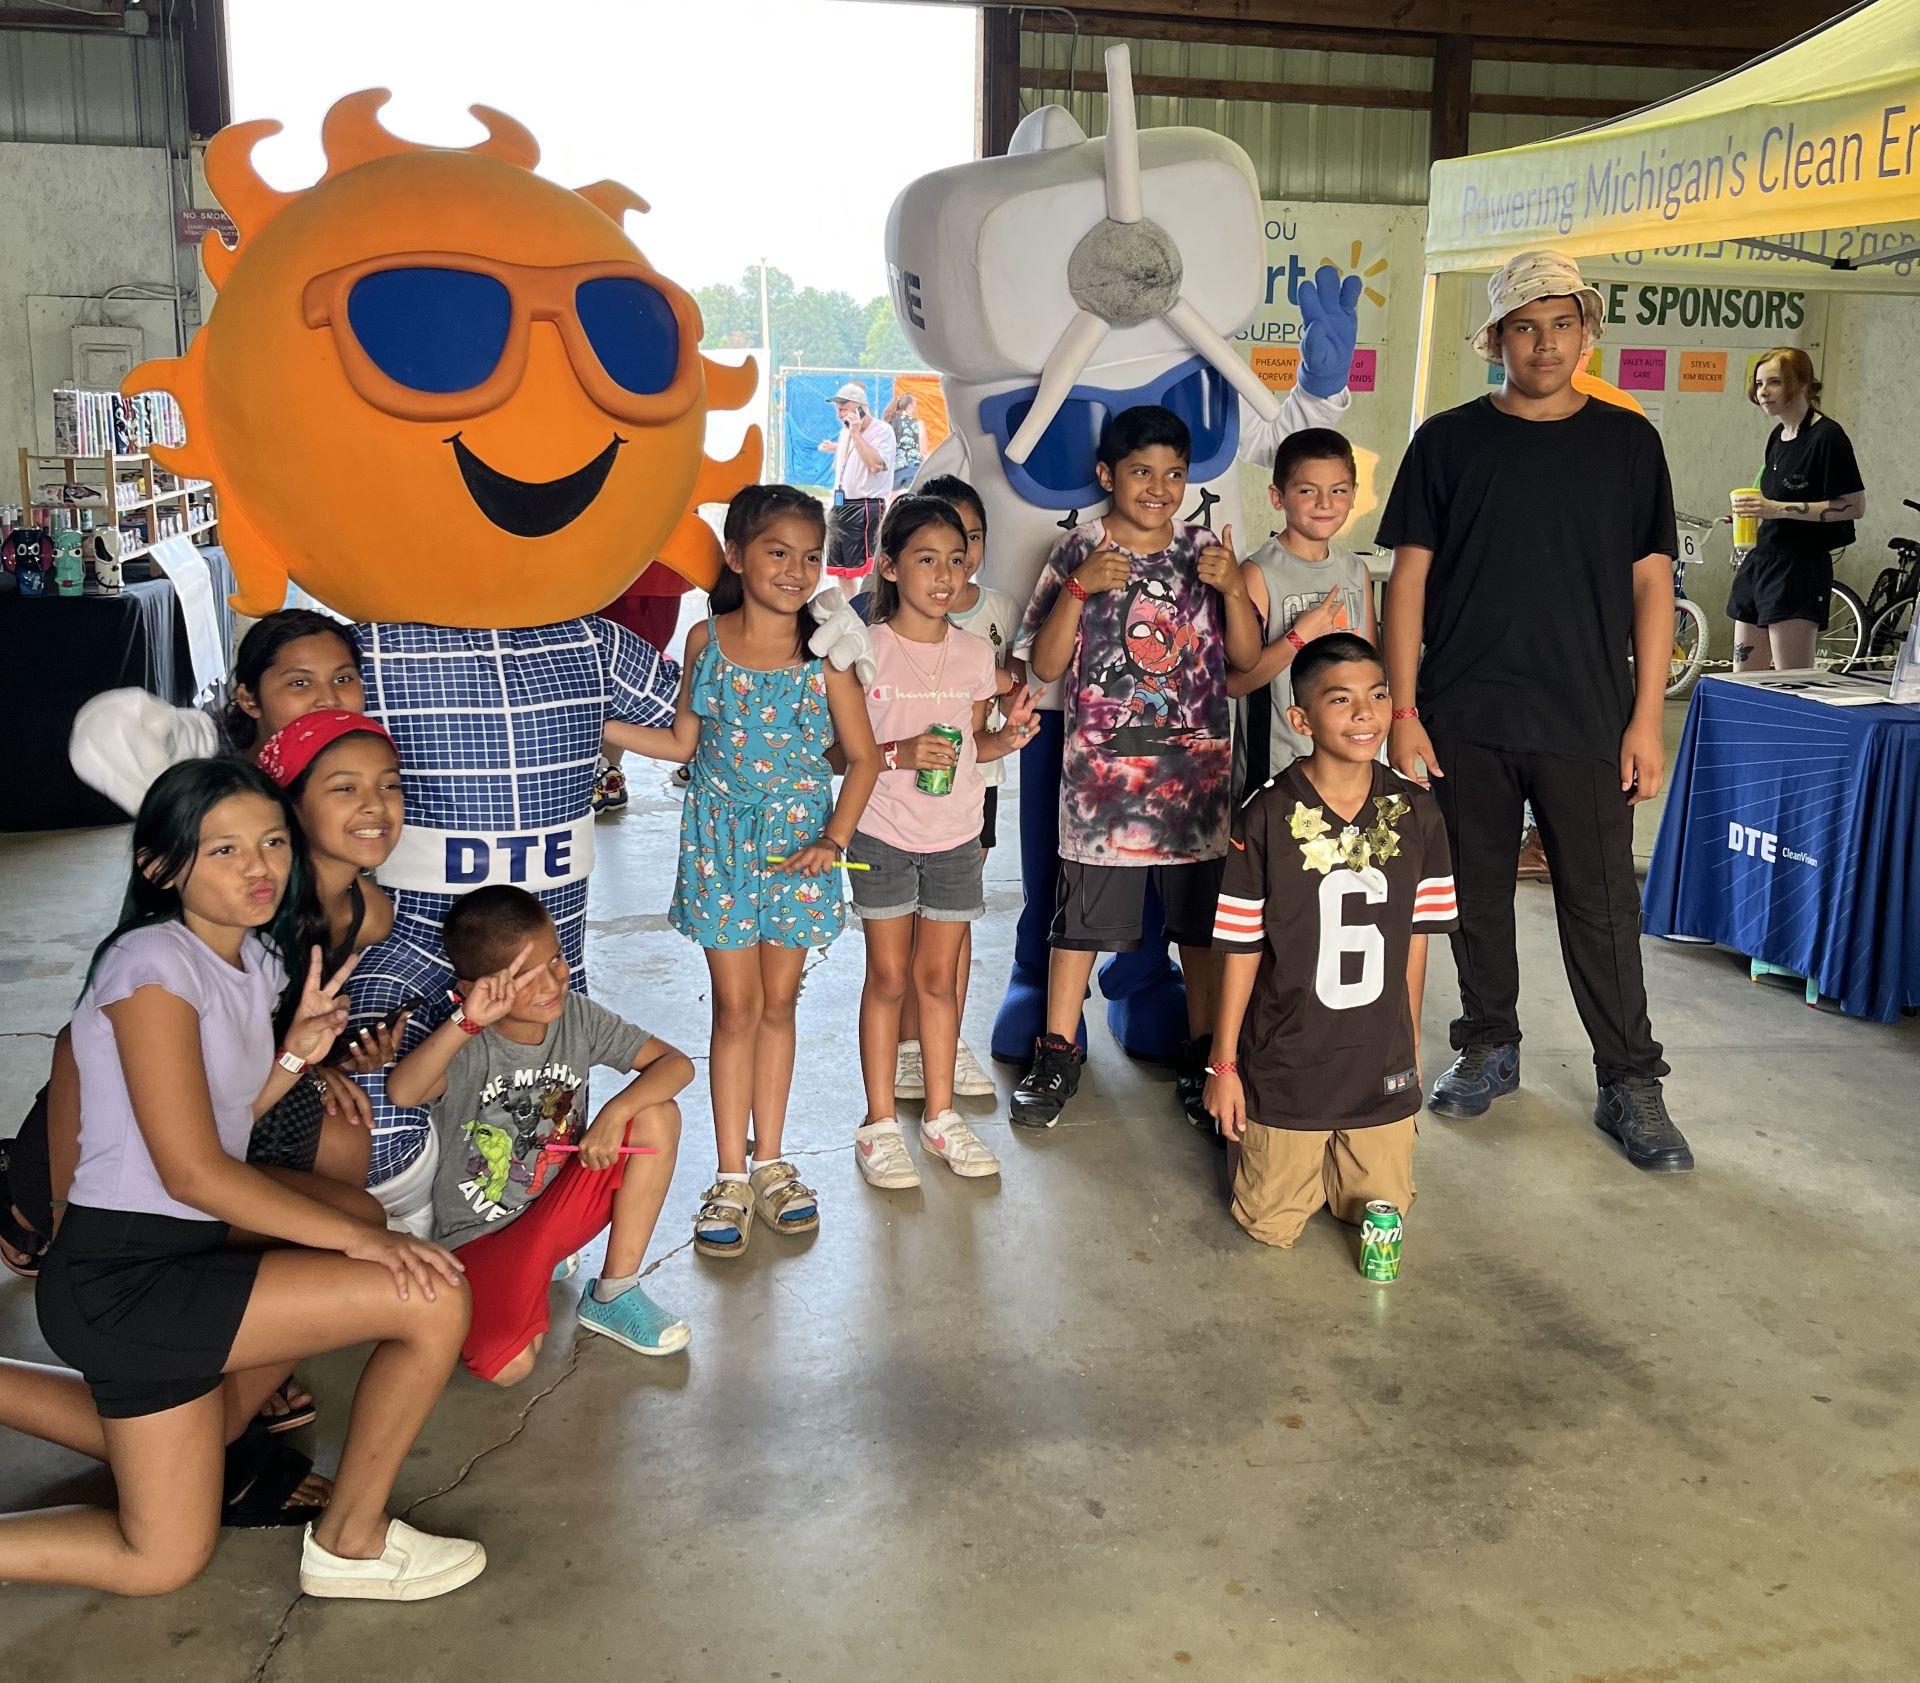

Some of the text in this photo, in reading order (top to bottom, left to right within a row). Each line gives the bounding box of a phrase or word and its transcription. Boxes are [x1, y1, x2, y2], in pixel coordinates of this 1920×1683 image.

[1460, 172, 1577, 235] Powering
[1583, 135, 1748, 221] Michigan's
[1759, 122, 1863, 193] Clean
[1636, 285, 1806, 329] SPONSORS
[1255, 359, 1298, 367] PHEASANT
[1623, 358, 1664, 367] VALET AUTO
[1690, 361, 1711, 369] STEVE
[1258, 373, 1294, 381] FOREVER
[1685, 535, 1694, 555] 6
[870, 684, 971, 705] Champion
[1728, 821, 1778, 864] DTE
[445, 829, 573, 884] DTE
[1315, 868, 1388, 1010] 6
[480, 1074, 507, 1104] HE
